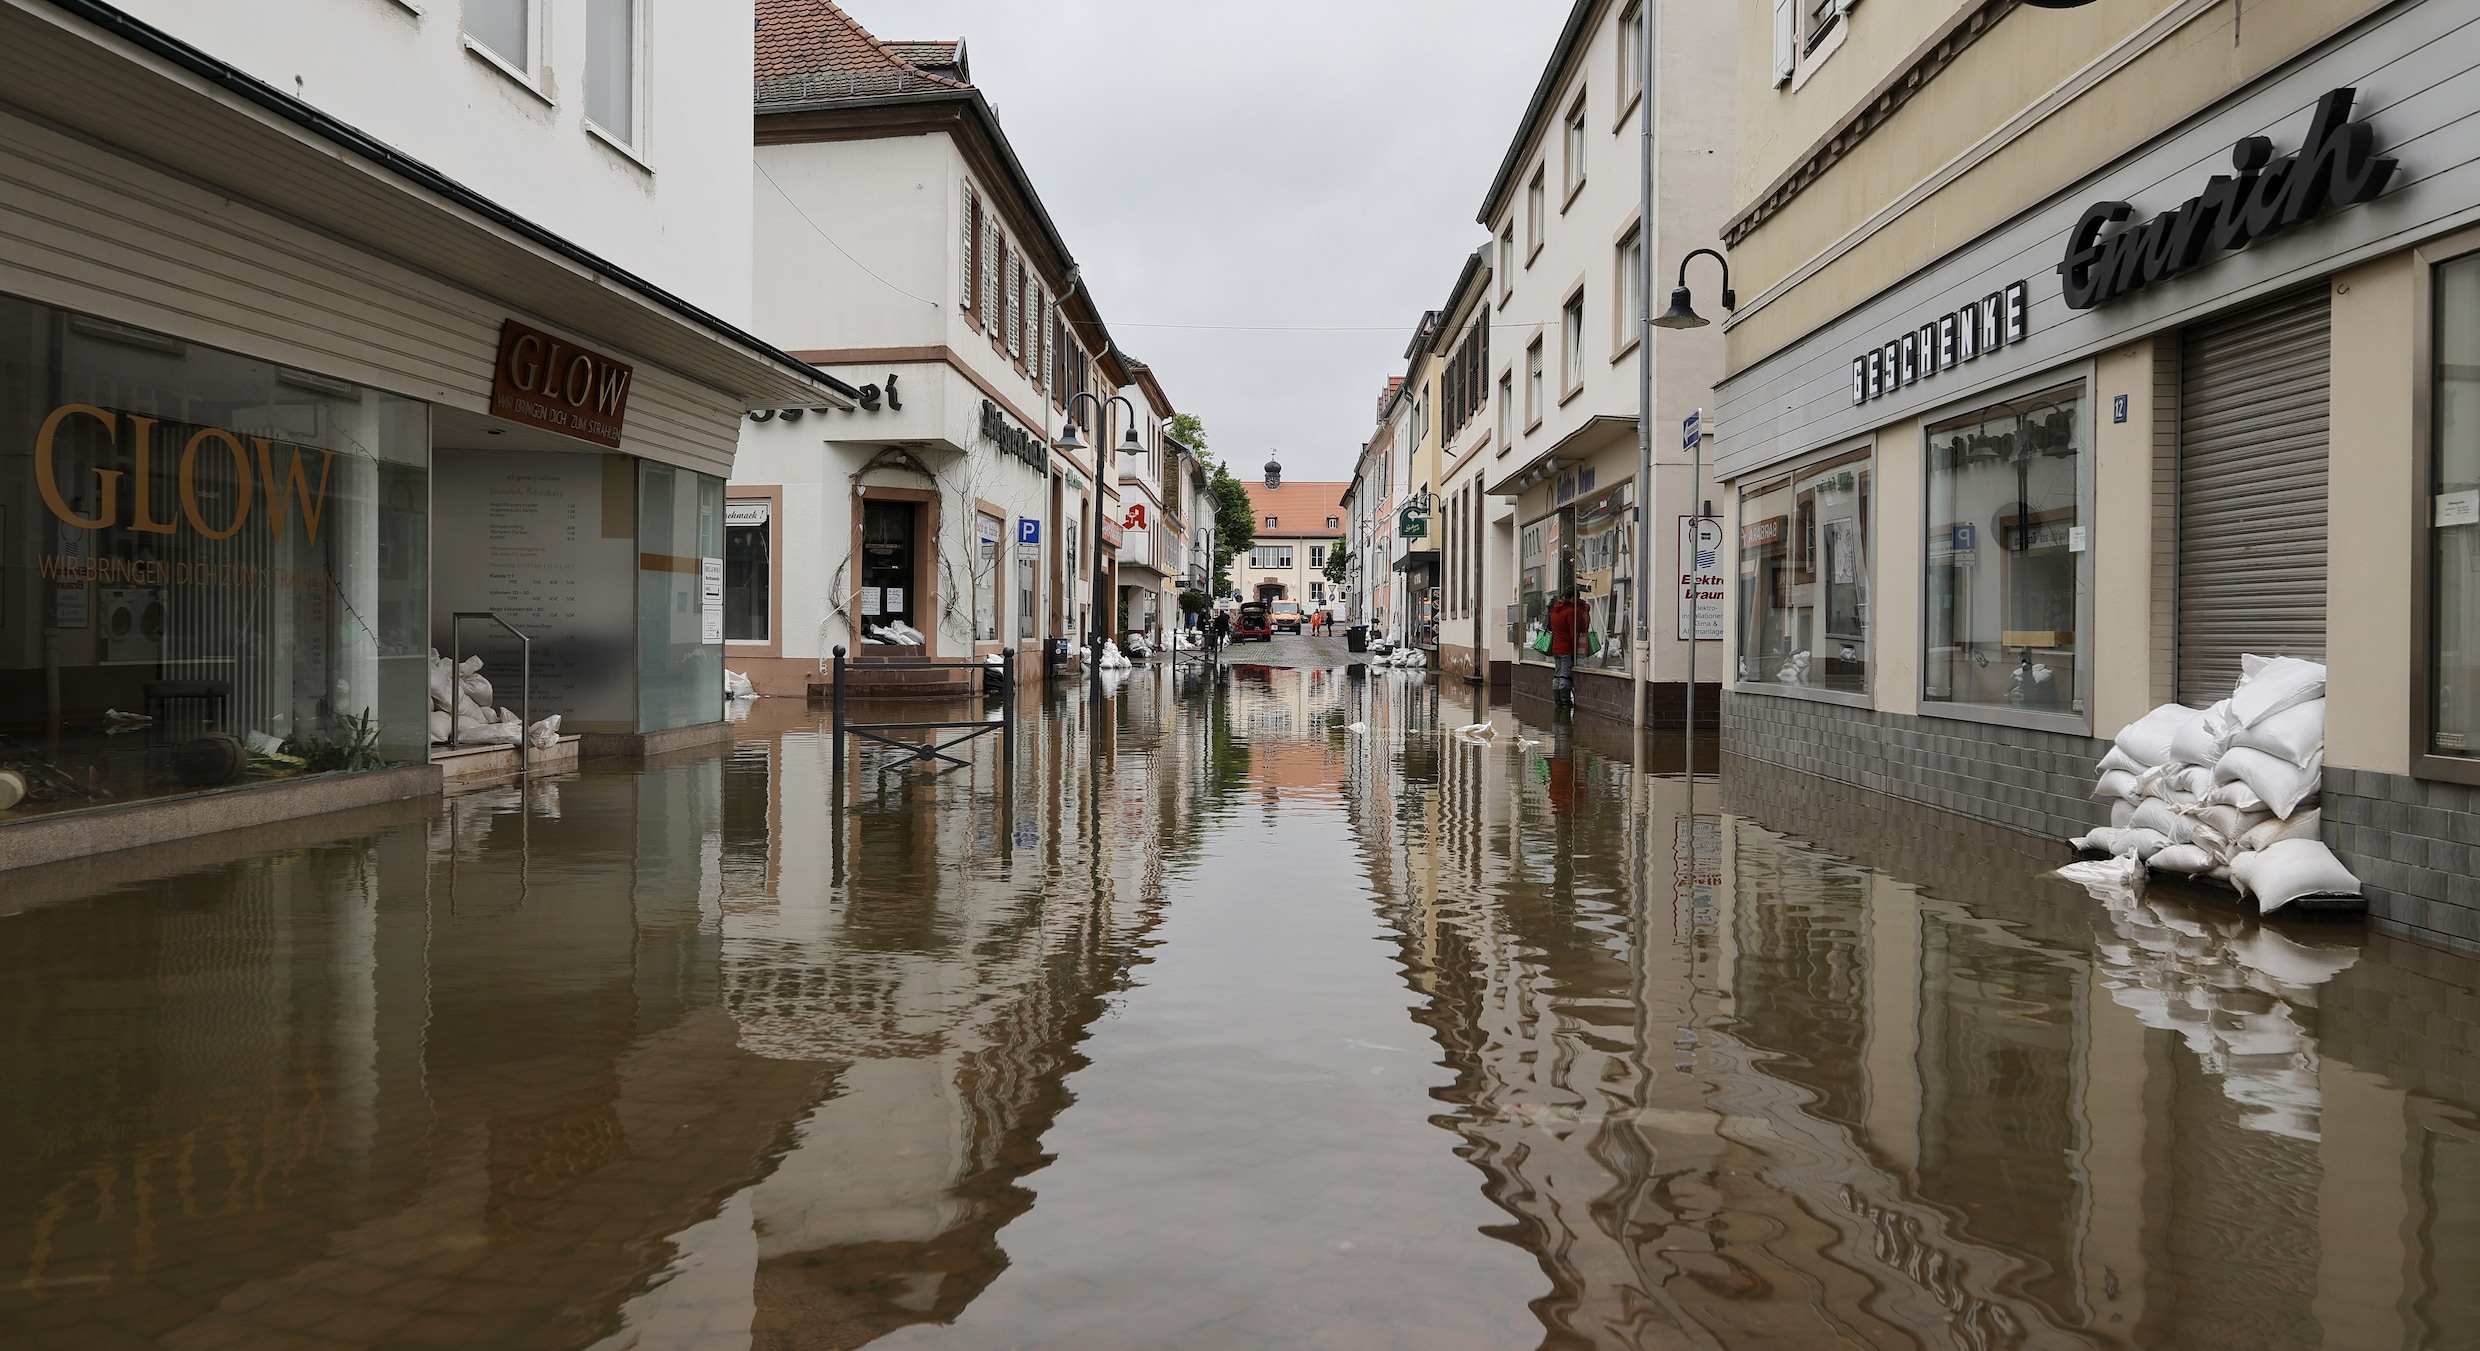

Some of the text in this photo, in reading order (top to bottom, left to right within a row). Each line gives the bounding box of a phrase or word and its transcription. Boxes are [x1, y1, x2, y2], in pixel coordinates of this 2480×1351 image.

[2056, 87, 2403, 310] Emrich
[1852, 279, 2026, 405] GESCHENKE
[509, 334, 629, 417] GLOW
[497, 392, 621, 440] WIR BRINGEN DICH ZUM STRAHLEN
[2115, 399, 2124, 417] 12
[34, 403, 337, 548] GLOW
[1023, 521, 1036, 541] P
[37, 552, 336, 590] WIR BRINGEN DICH ZUM STRAHLEN
[1681, 574, 1724, 585] Eektr
